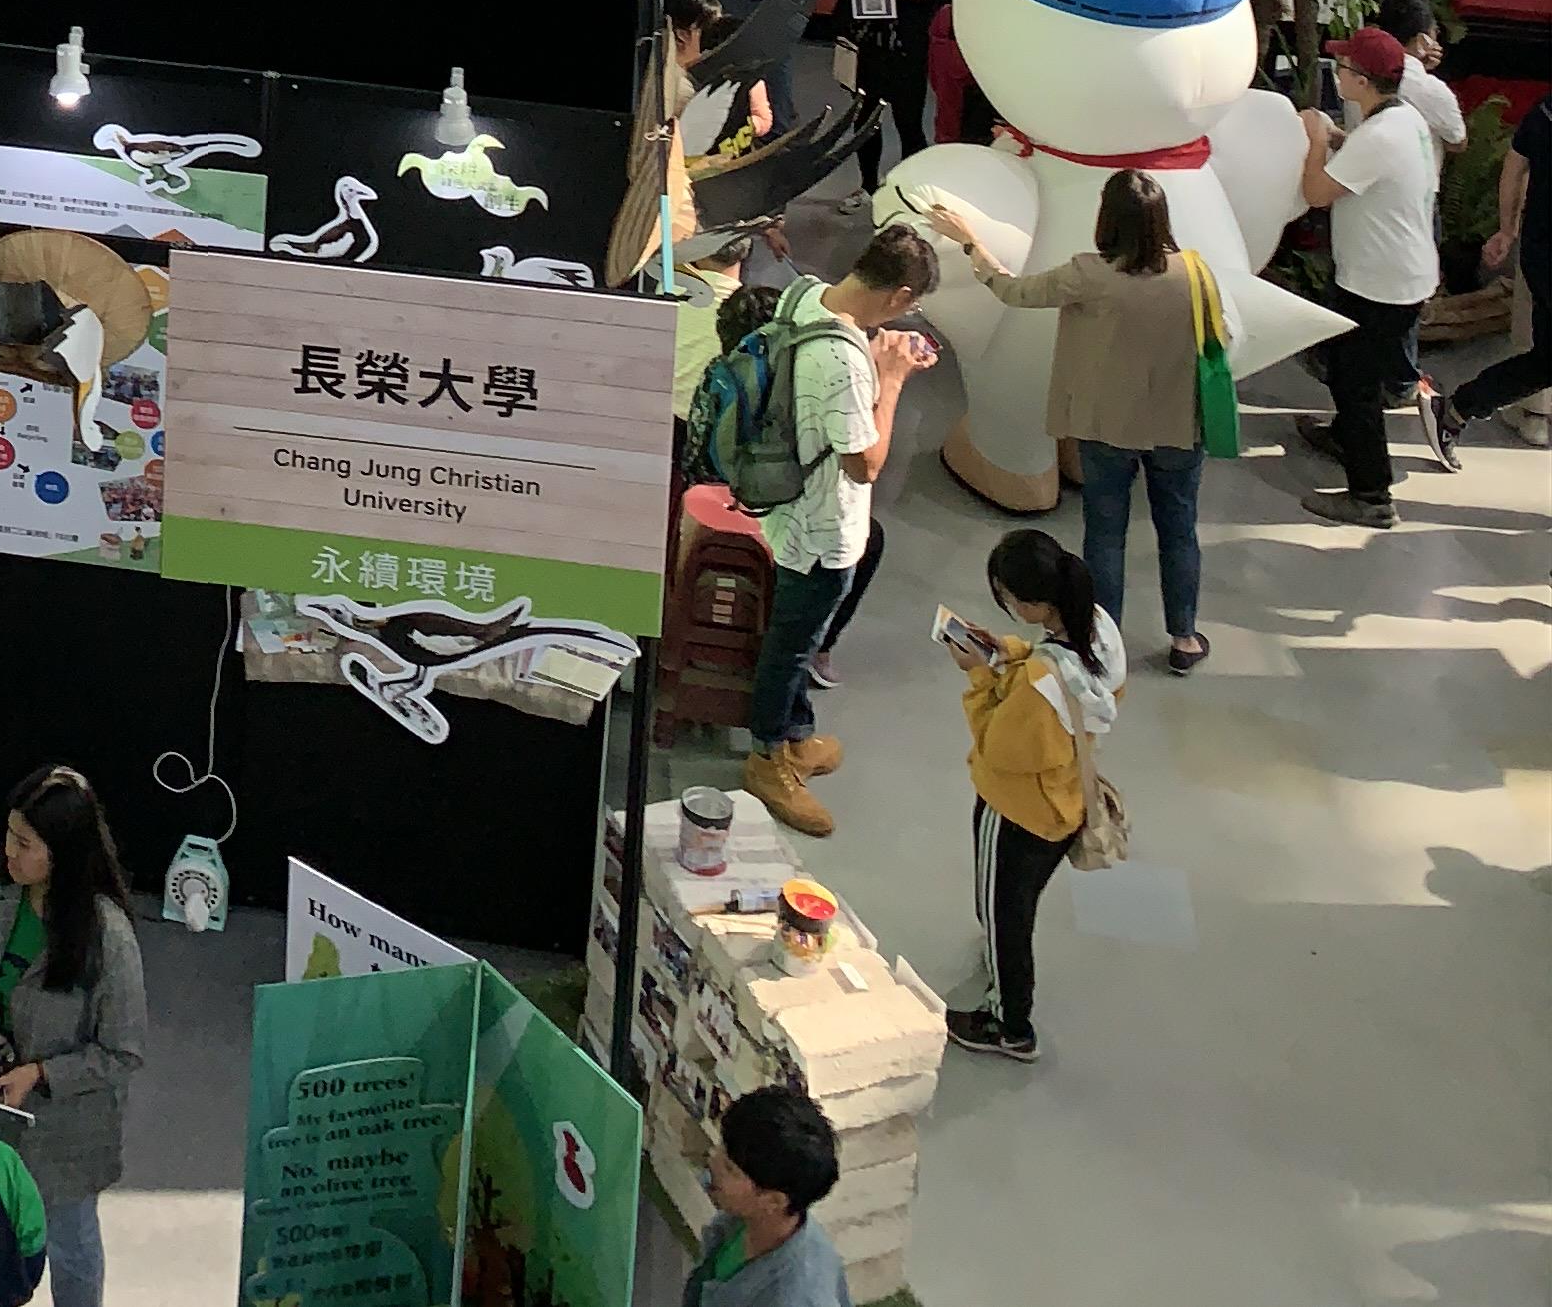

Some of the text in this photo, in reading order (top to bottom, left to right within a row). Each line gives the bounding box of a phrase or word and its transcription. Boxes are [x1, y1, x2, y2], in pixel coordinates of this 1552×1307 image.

[290, 342, 539, 418] 長榮大學
[272, 446, 542, 497] Chang Jung Christian
[343, 486, 468, 525] University
[310, 544, 498, 604] 永續環境
[307, 896, 362, 939] How
[296, 1076, 345, 1101] 500
[328, 1098, 416, 1123] favourite
[267, 1136, 301, 1150] tree
[305, 1132, 320, 1145] is
[325, 1127, 351, 1142] an
[356, 1118, 395, 1136] oak
[327, 1147, 410, 1175] maybe
[280, 1174, 412, 1199] an olive tree
